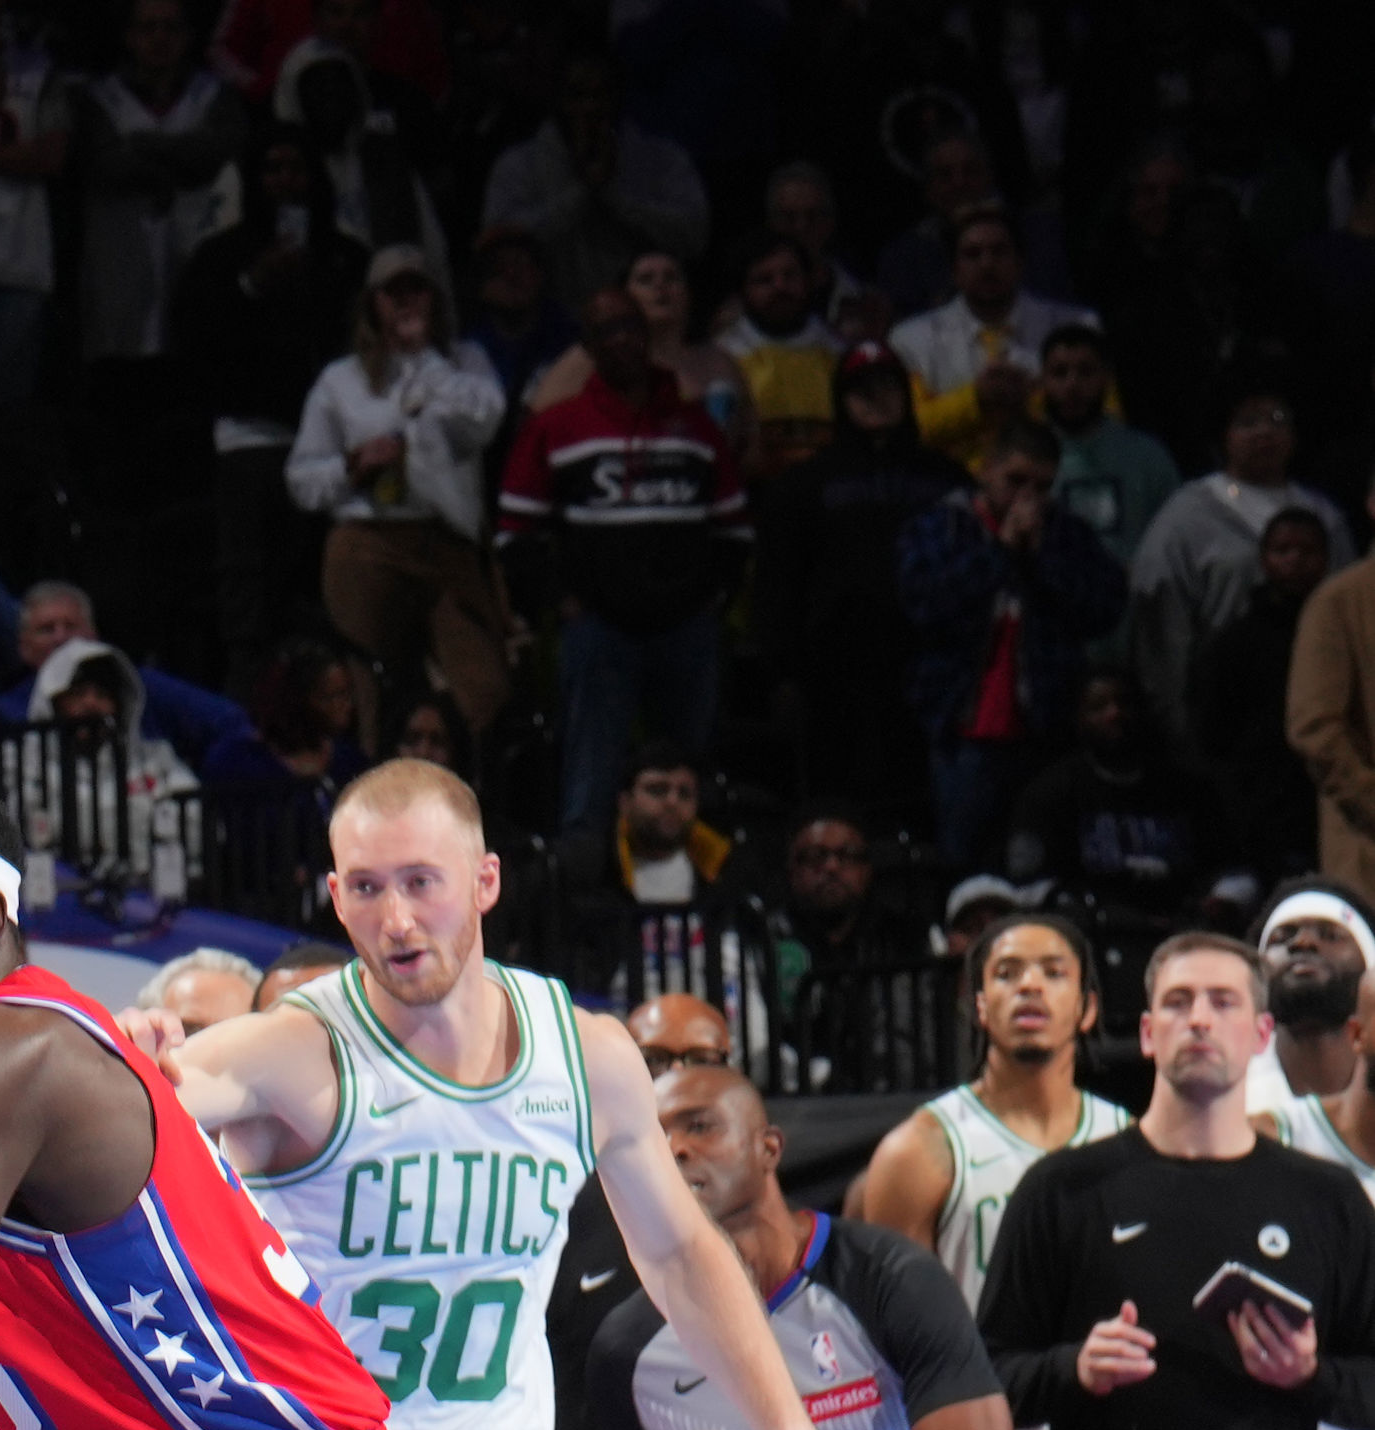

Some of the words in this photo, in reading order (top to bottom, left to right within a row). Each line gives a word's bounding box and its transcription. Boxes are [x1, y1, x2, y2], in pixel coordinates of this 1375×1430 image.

[514, 1095, 570, 1117] Amica
[338, 1150, 568, 1259] CELTICS
[350, 1278, 525, 1403] 30
[802, 1384, 879, 1418] mirates
